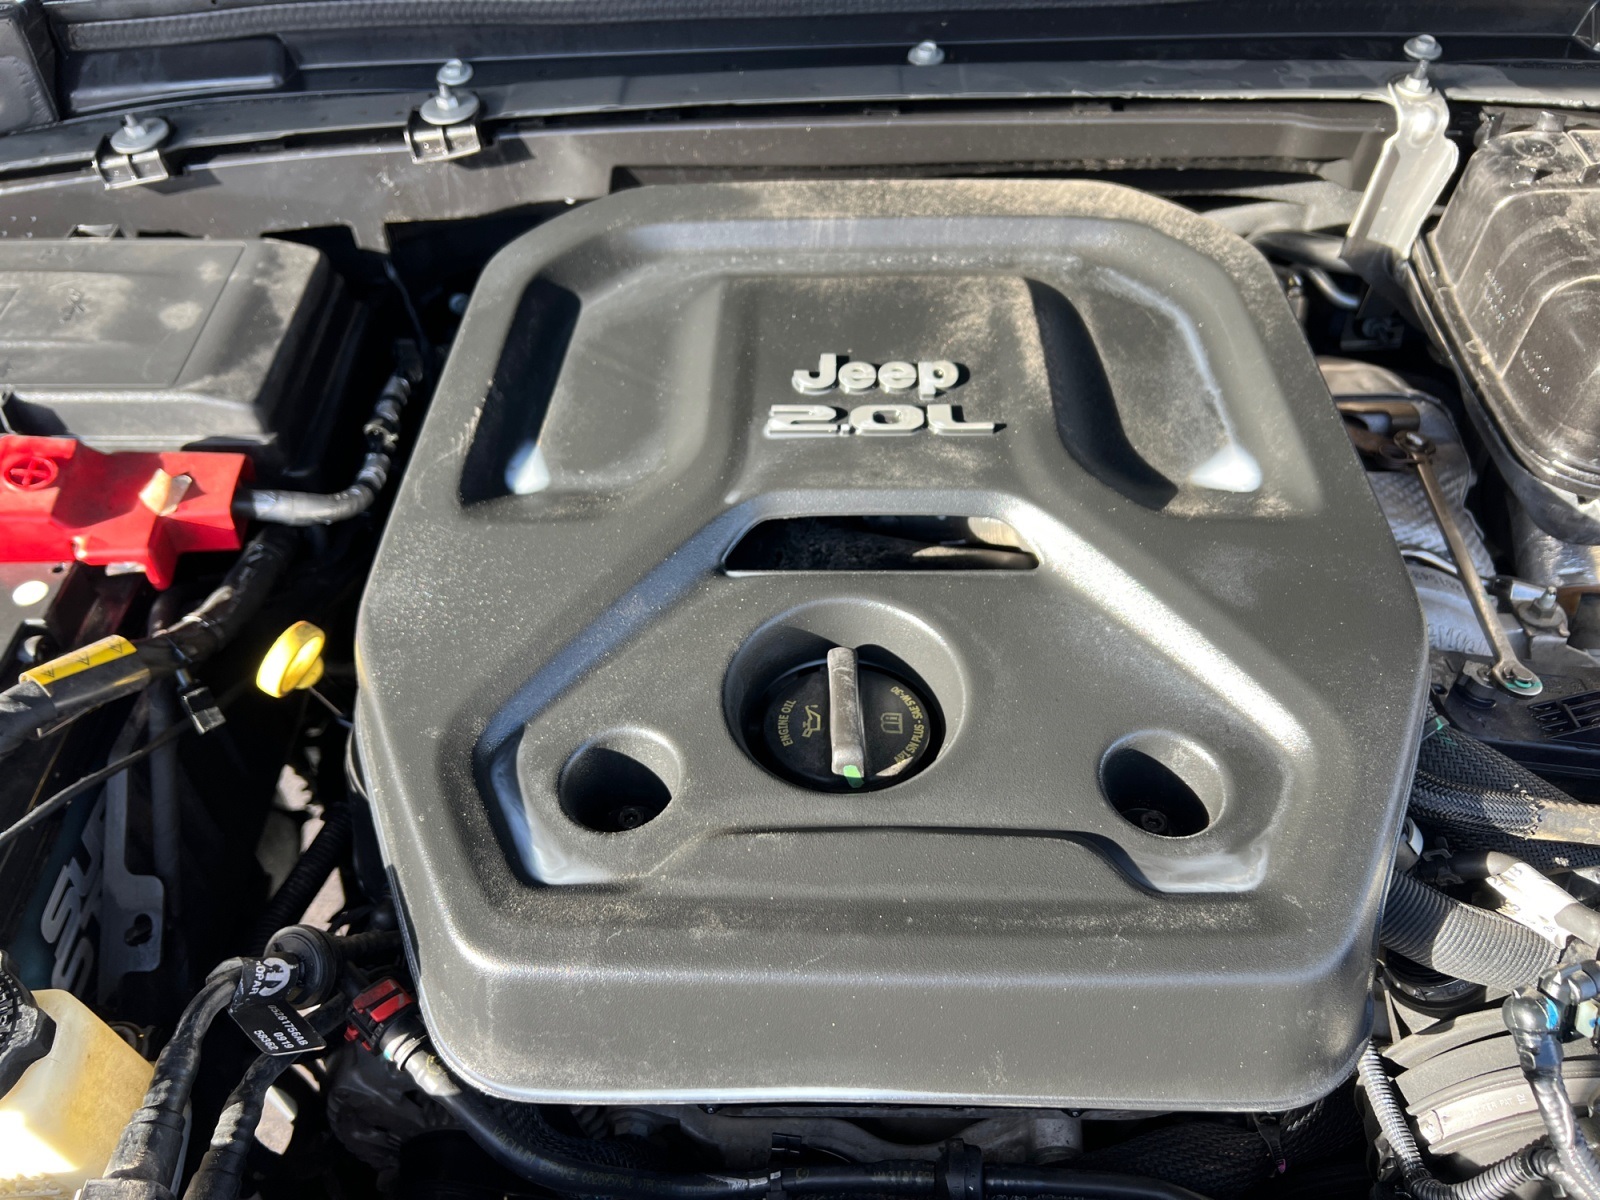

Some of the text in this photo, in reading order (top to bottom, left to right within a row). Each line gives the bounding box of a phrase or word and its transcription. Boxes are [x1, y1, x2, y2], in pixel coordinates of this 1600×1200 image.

[792, 353, 959, 400] Jeep
[765, 404, 996, 438] 2.0L
[908, 706, 924, 720] SAE
[777, 700, 797, 747] ENGINE OIL
[911, 724, 925, 743] PLUS
[894, 749, 912, 764] API
[273, 1031, 295, 1049] 0919
